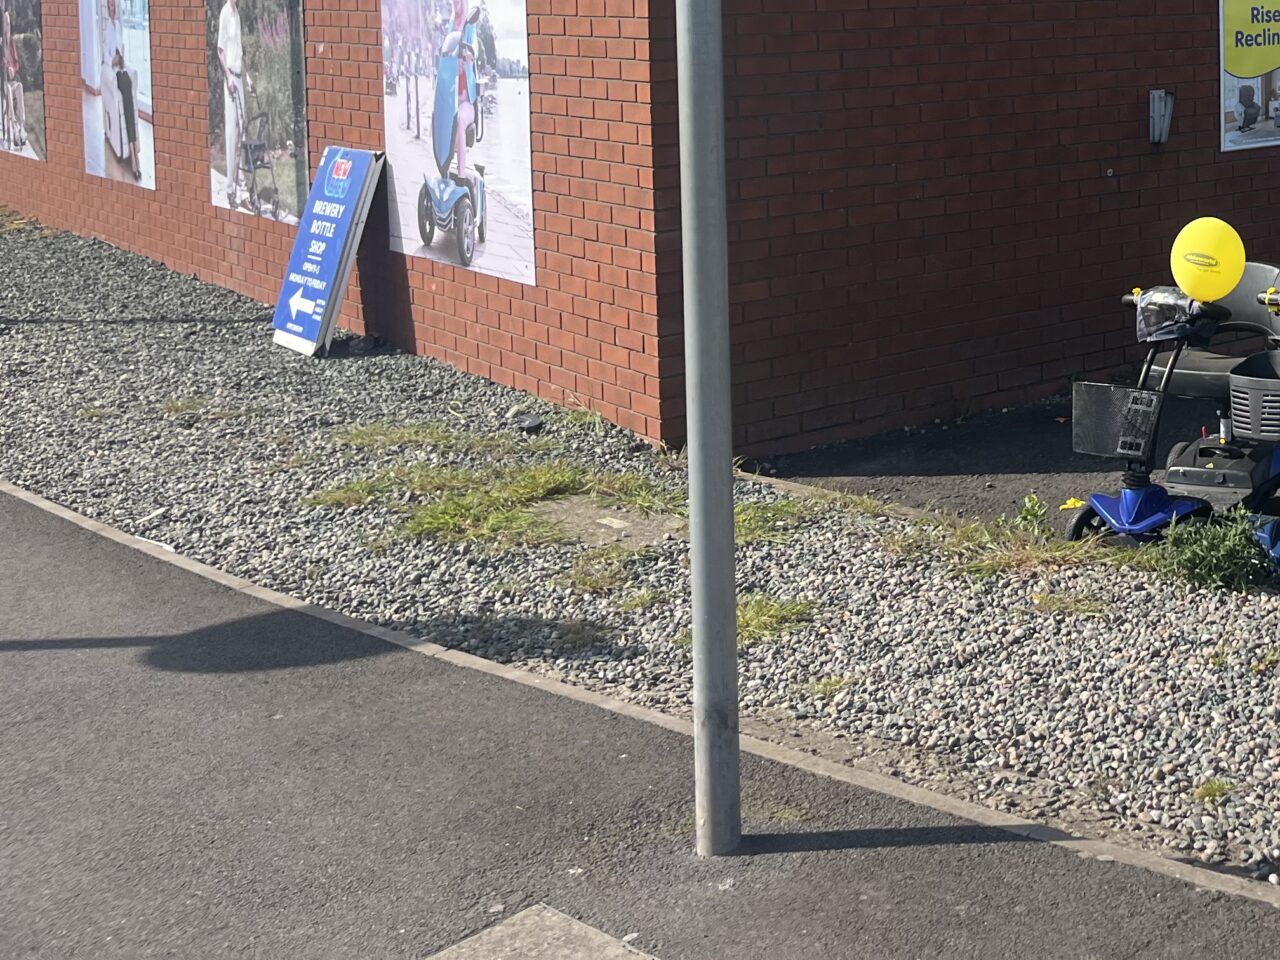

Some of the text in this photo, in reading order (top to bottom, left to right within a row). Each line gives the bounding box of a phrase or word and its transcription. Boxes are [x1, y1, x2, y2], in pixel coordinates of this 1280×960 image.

[313, 200, 345, 219] BREWERY
[310, 219, 336, 238] BOTTLE
[308, 239, 327, 255] SHOP
